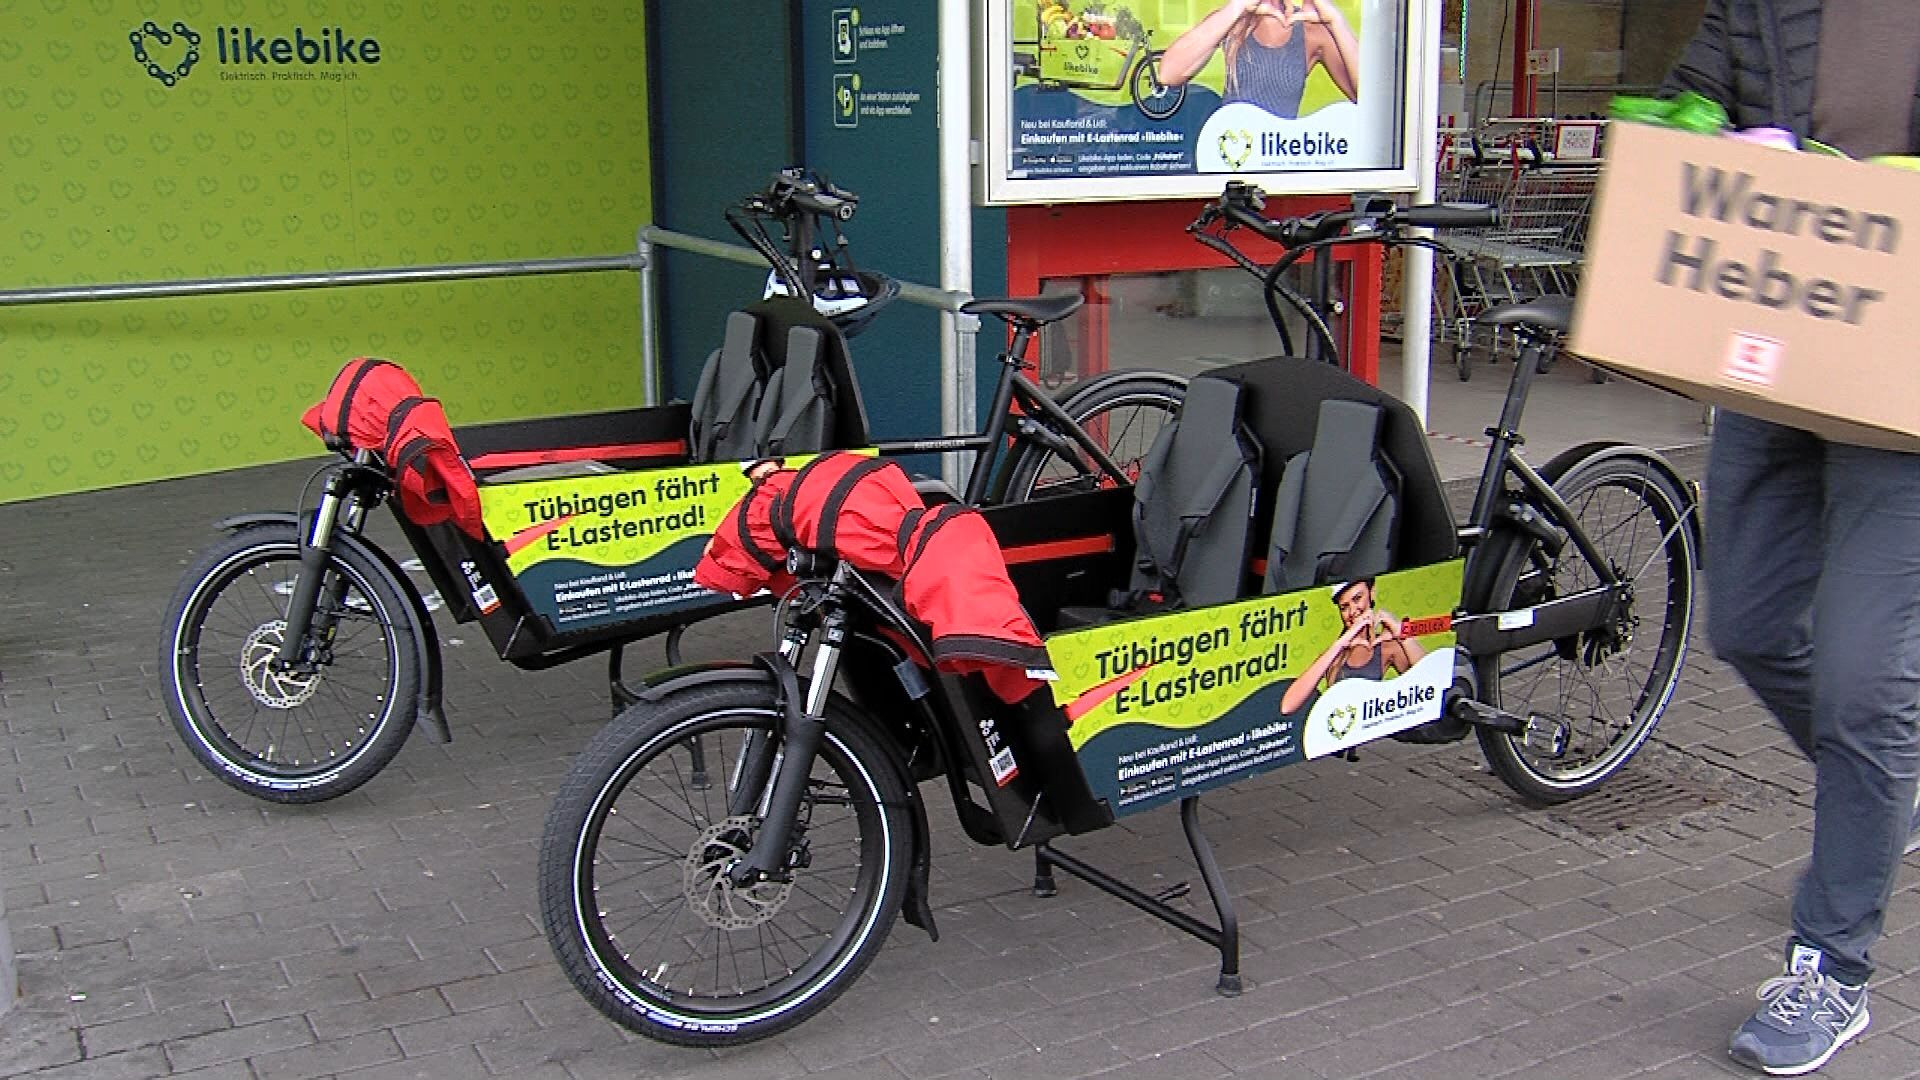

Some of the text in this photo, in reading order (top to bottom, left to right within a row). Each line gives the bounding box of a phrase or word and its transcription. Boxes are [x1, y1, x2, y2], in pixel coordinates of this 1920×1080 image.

[217, 26, 381, 64] likebike
[1021, 133, 1067, 144] Einkaufen
[1069, 133, 1085, 143] mit
[1261, 132, 1348, 156] likebike
[1680, 161, 1903, 254] Waren
[1655, 230, 1887, 326] Heber
[524, 472, 720, 523] Tübingen fährt
[546, 505, 706, 551] E-Lastenrad!
[602, 583, 618, 594] mit
[1095, 600, 1308, 680] Tübingen fährt
[1115, 644, 1288, 714] E-Lastenrad!
[1362, 684, 1435, 720] likebike
[1118, 758, 1168, 781] Einkaufen
[1170, 750, 1187, 766] mit
